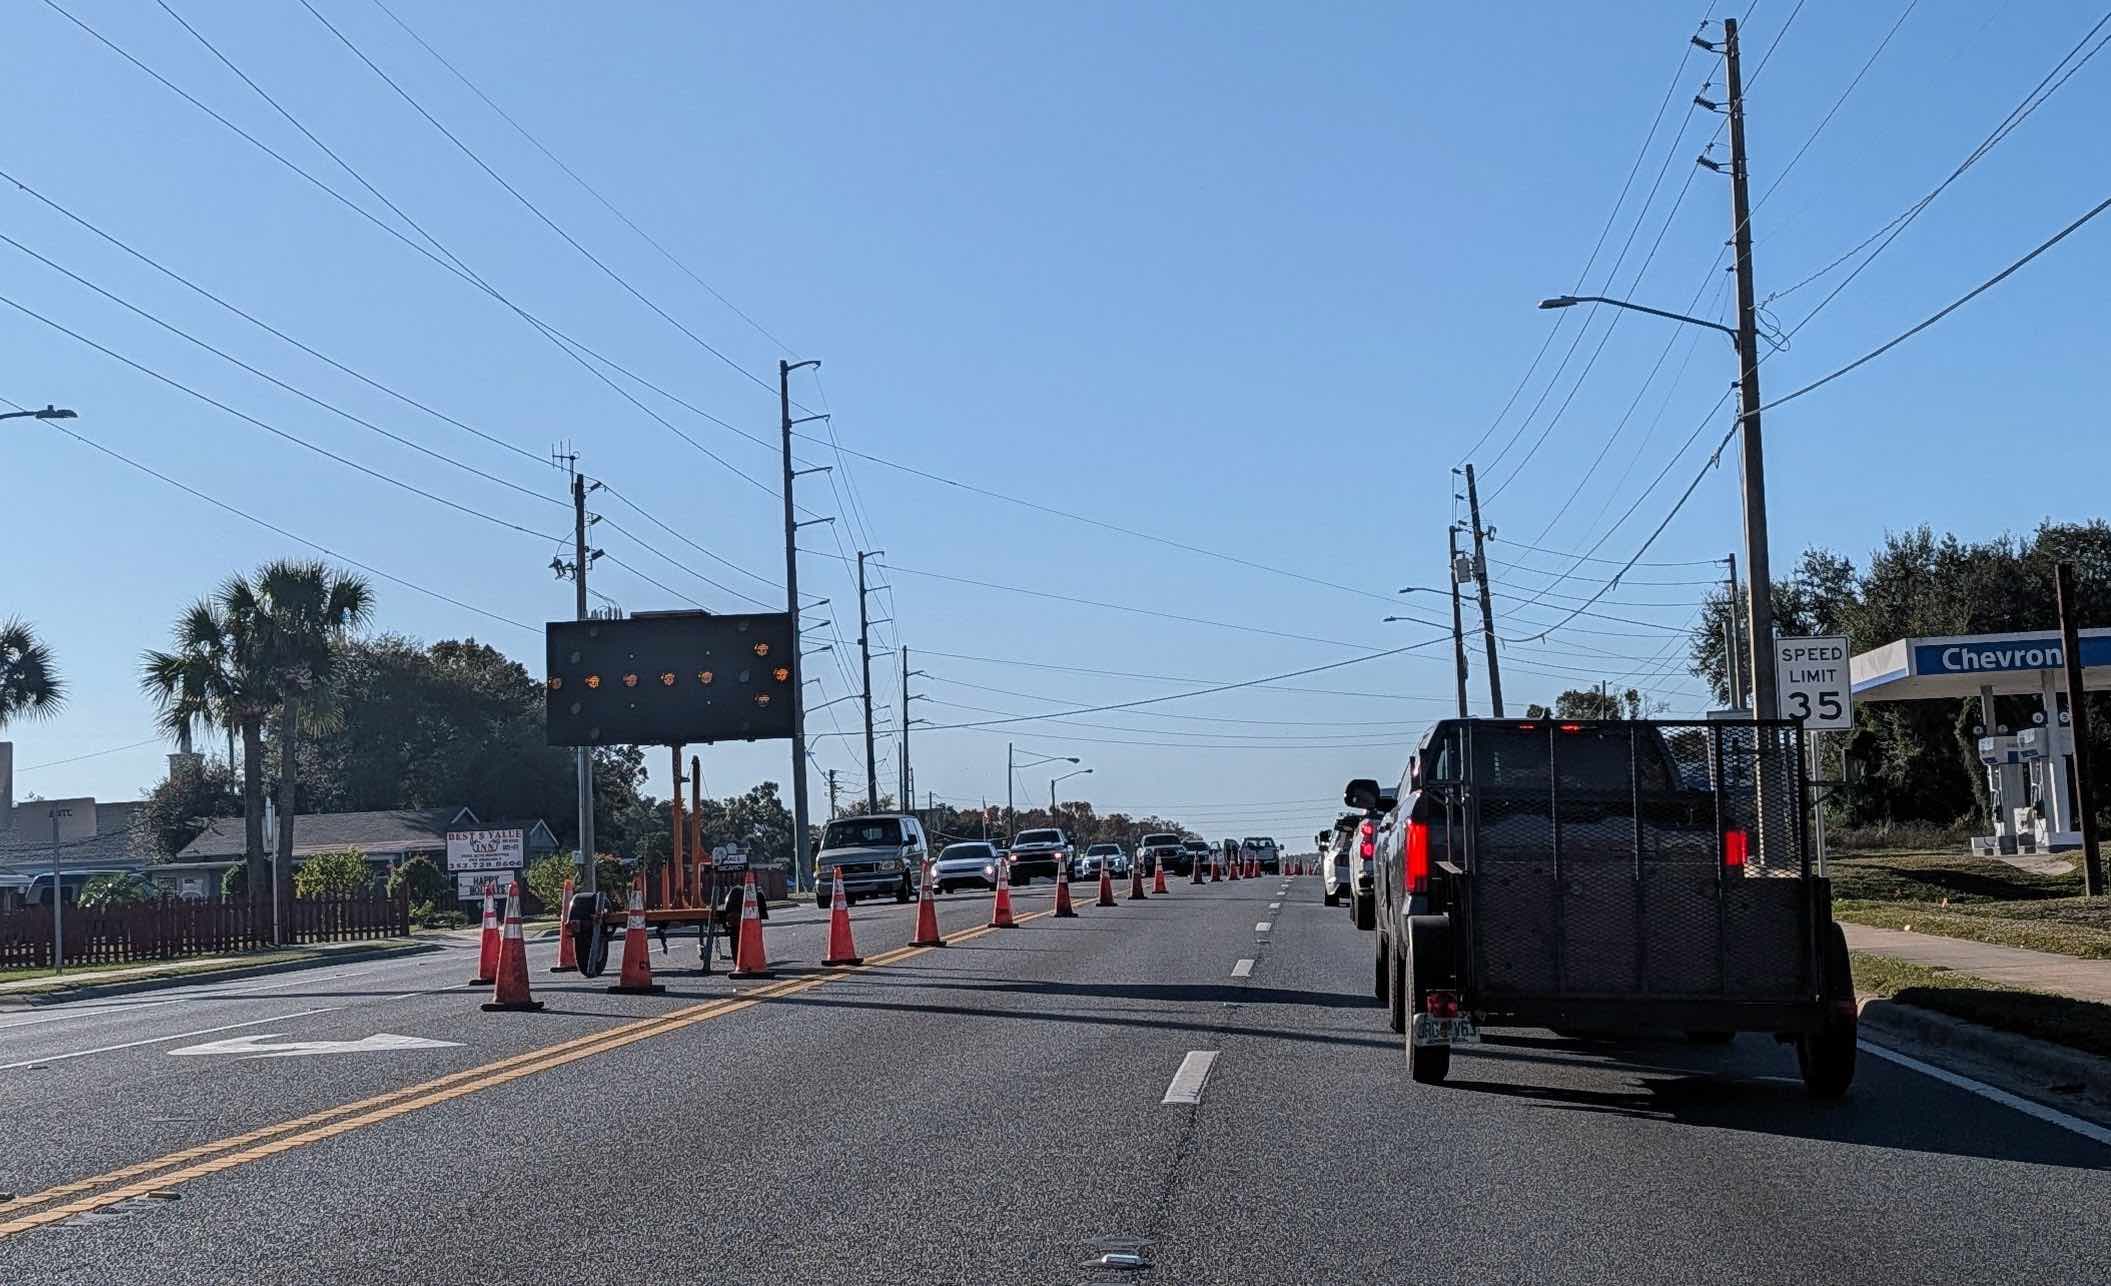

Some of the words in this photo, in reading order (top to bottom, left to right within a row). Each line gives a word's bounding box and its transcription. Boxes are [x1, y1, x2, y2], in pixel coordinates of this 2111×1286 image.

[1782, 648, 1842, 661] SPEED
[1942, 647, 2063, 670] Chevron
[1790, 669, 1837, 683] LIMIT
[1788, 691, 1842, 720] 35
